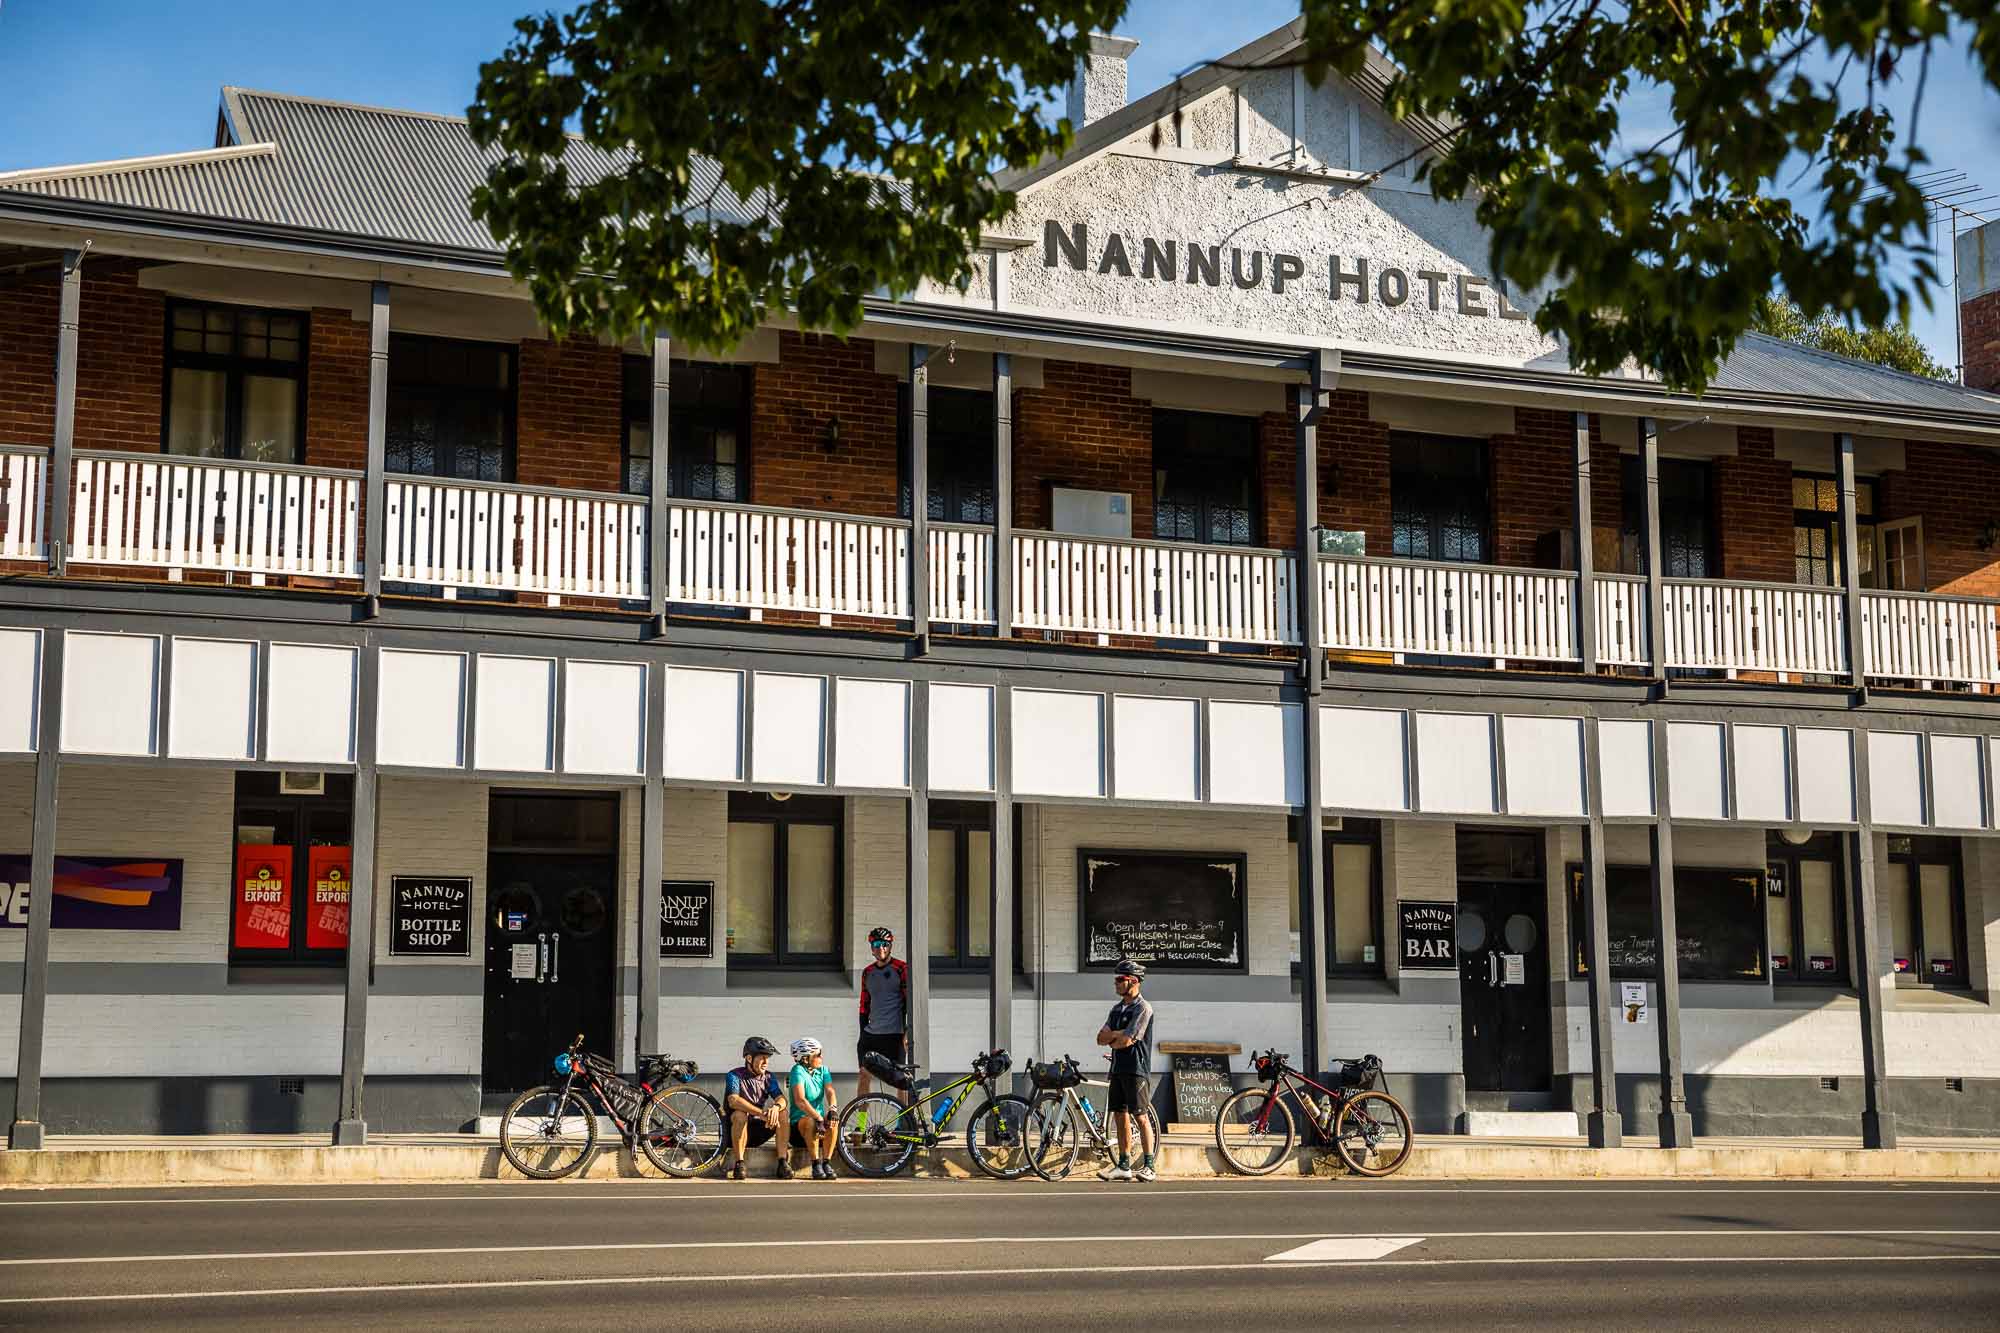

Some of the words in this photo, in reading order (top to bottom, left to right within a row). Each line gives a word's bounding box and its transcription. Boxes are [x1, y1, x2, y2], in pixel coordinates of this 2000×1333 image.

[1043, 219, 1305, 295] NANNUP
[1329, 254, 1527, 320] HOTEL
[245, 880, 282, 891] EMU
[316, 880, 351, 892] EMU
[245, 891, 282, 902] EXPORT
[401, 885, 464, 901] NANNUP
[414, 901, 451, 911] HOTEL
[659, 895, 708, 909] ANNUP
[251, 904, 290, 926] EMU
[322, 904, 349, 922] EM
[1404, 908, 1452, 923] NANNUP
[247, 916, 289, 938] EXPORT
[318, 916, 349, 936] EXPO
[401, 918, 461, 932] BOTTLE
[673, 919, 698, 927] WINES
[1106, 921, 1135, 934] Open
[1415, 922, 1442, 931] HOTEL
[409, 933, 452, 946] SHOP
[660, 936, 675, 946] LD
[676, 936, 707, 947] HERE
[1406, 938, 1452, 958] BAR
[1179, 1070, 1204, 1080] Lunch
[1180, 1093, 1214, 1106] Dinner
